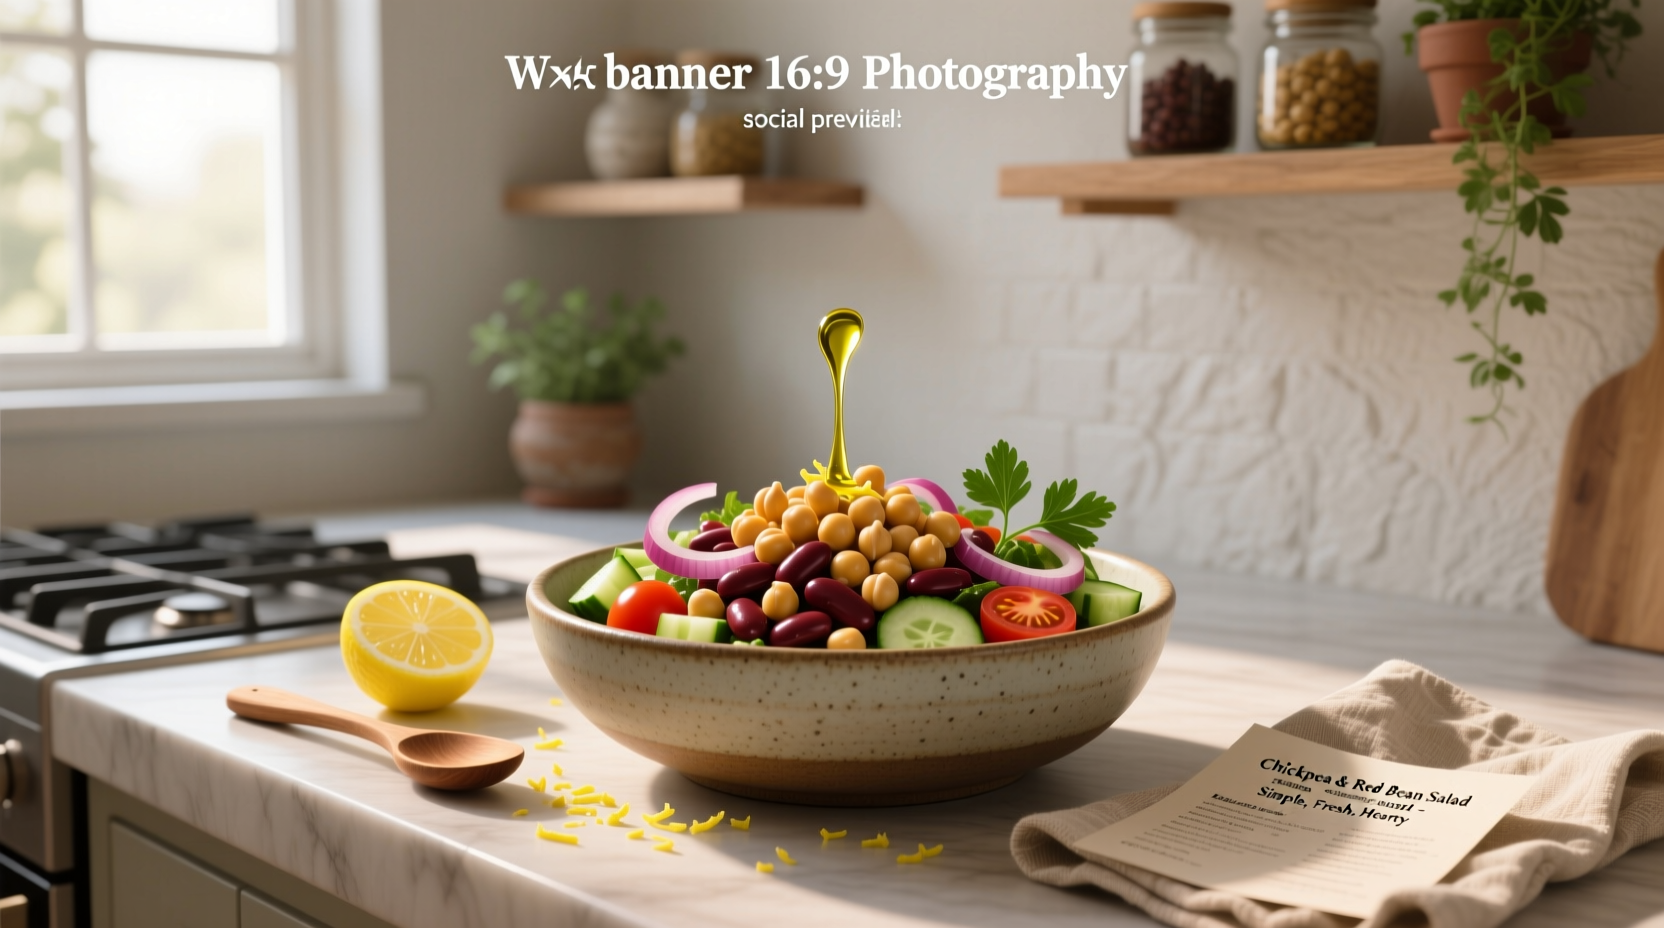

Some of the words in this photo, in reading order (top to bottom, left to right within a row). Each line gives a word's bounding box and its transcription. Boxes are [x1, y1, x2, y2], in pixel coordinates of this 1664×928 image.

[1257, 786, 1308, 809] Simple,
[1313, 798, 1356, 817] Fresh,
[1260, 758, 1332, 785] Chickpea
[1335, 776, 1349, 788] &
[1353, 778, 1385, 794] Red
[1386, 785, 1423, 801] Bean
[1425, 791, 1473, 808] Salad
